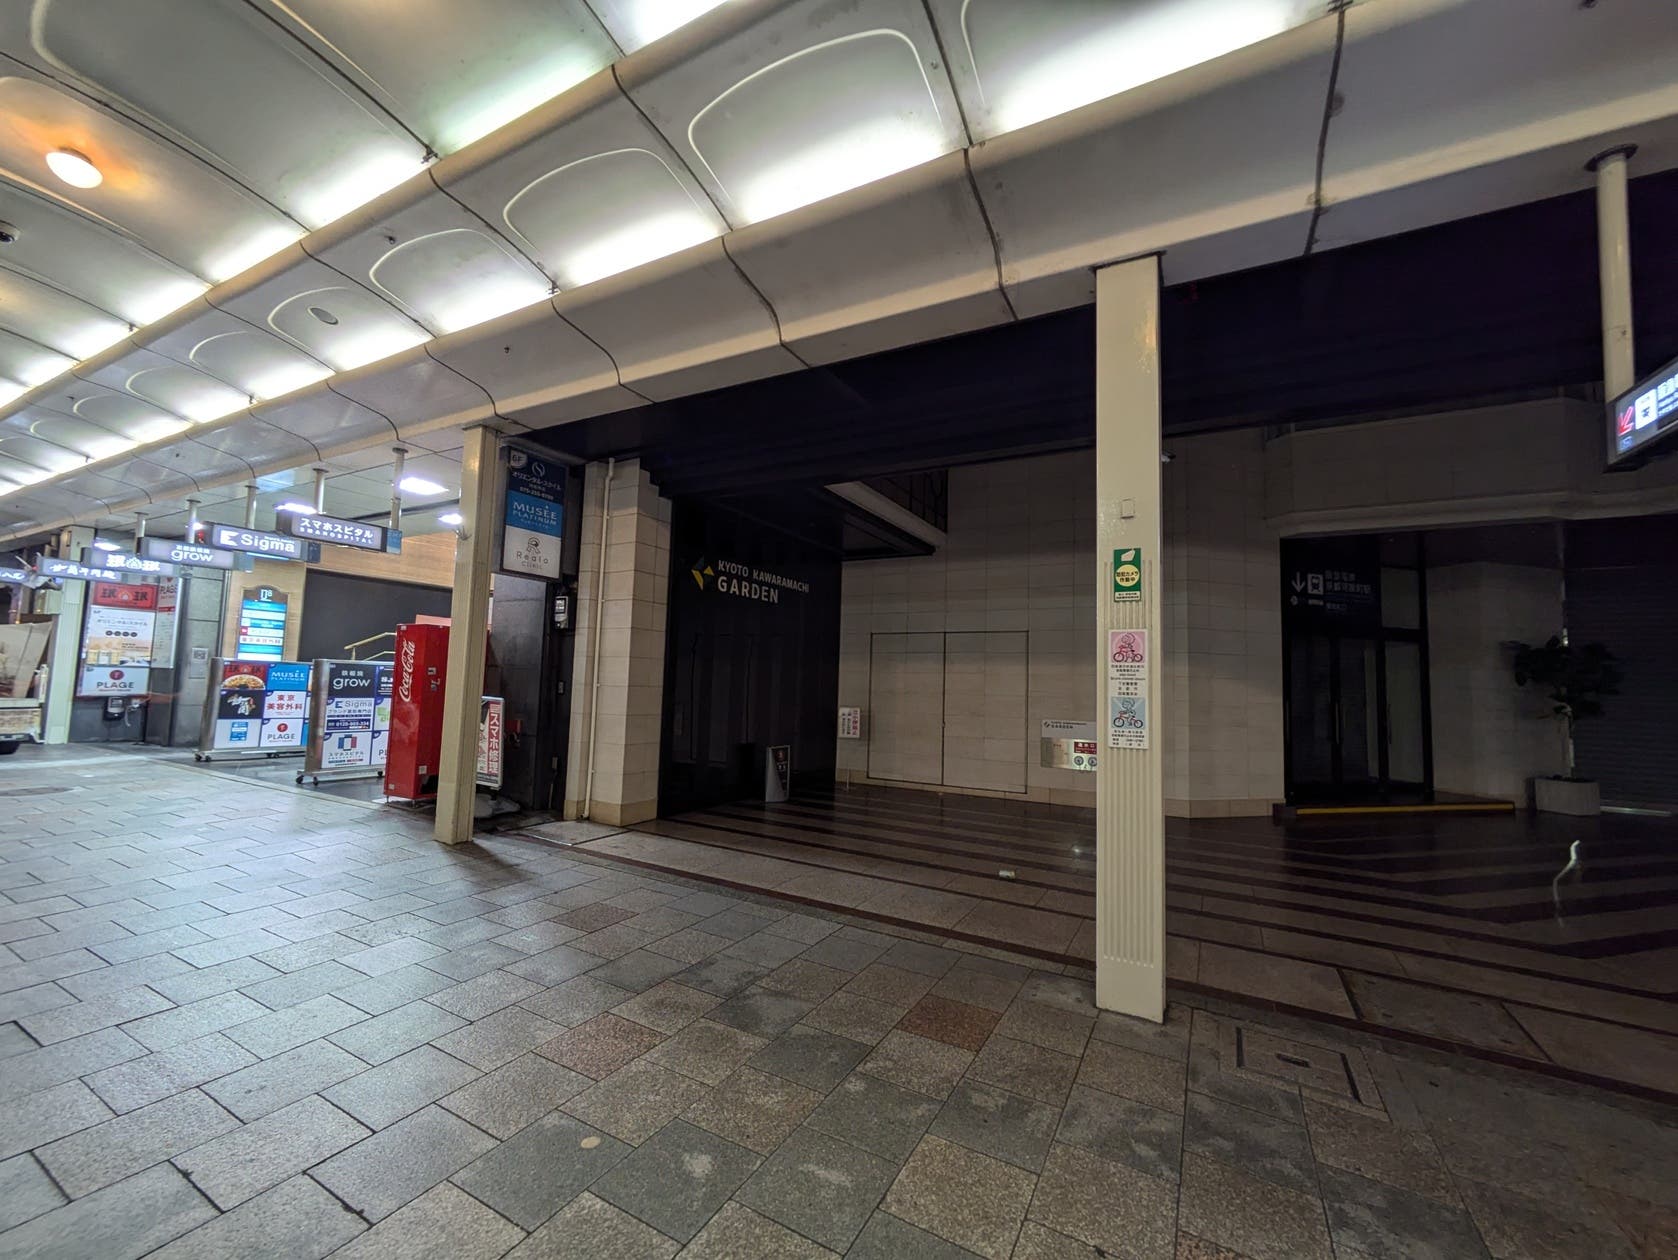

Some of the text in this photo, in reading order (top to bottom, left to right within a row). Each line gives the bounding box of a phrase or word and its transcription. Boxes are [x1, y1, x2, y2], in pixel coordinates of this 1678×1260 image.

[301, 517, 373, 539] スマホスピタル
[240, 533, 295, 553] Sigma
[171, 549, 214, 562] grow
[718, 559, 810, 593] KYOTO KAWARAMACHI
[717, 576, 779, 604] GARDEN
[96, 681, 135, 689] PLAGE
[333, 678, 371, 690] grow
